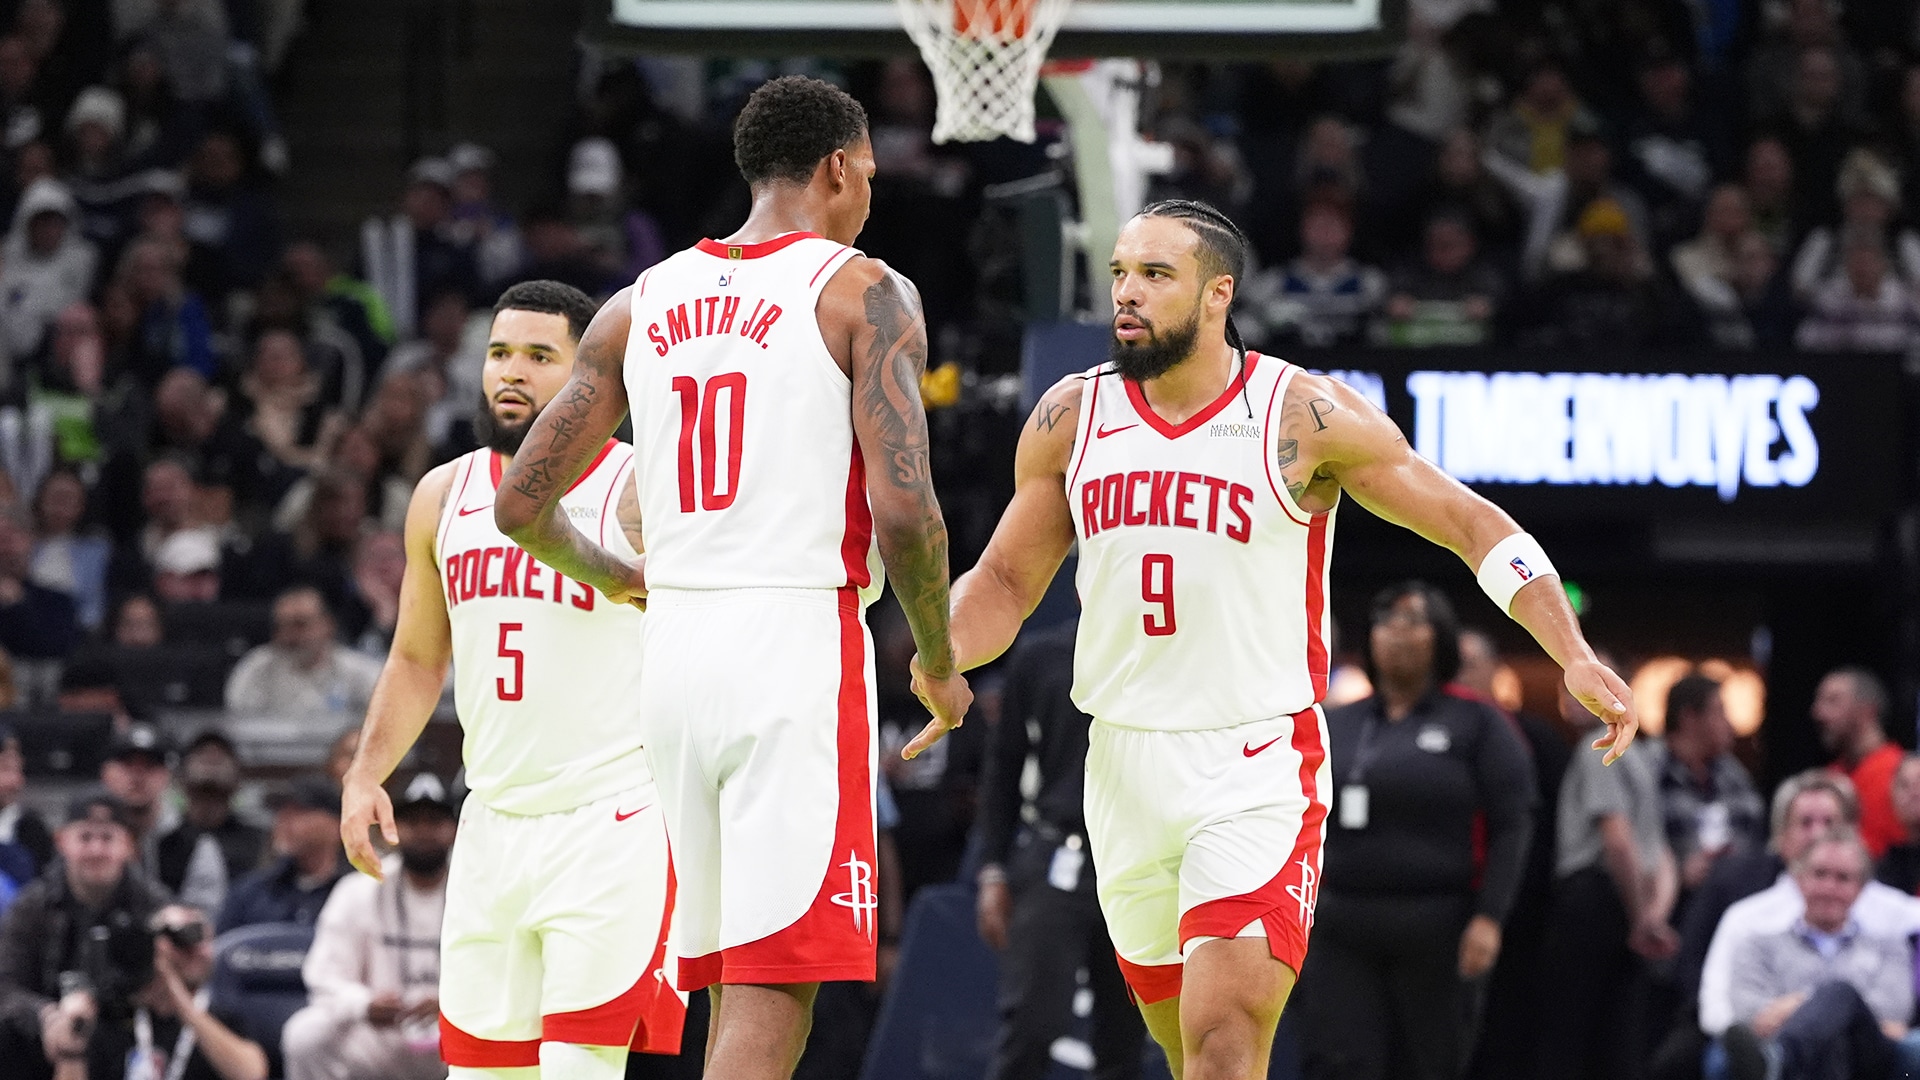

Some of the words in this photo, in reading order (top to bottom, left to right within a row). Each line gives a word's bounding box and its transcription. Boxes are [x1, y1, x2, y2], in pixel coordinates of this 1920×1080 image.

[647, 295, 741, 358] SMITH
[740, 298, 783, 350] JR.
[671, 371, 747, 513] 10
[1210, 423, 1261, 433] MEMORIAL
[1210, 430, 1260, 439] HERMANN
[1303, 397, 1335, 434] P
[1081, 470, 1255, 545] ROCKETS
[1142, 553, 1177, 637] 9
[496, 622, 524, 702] 5
